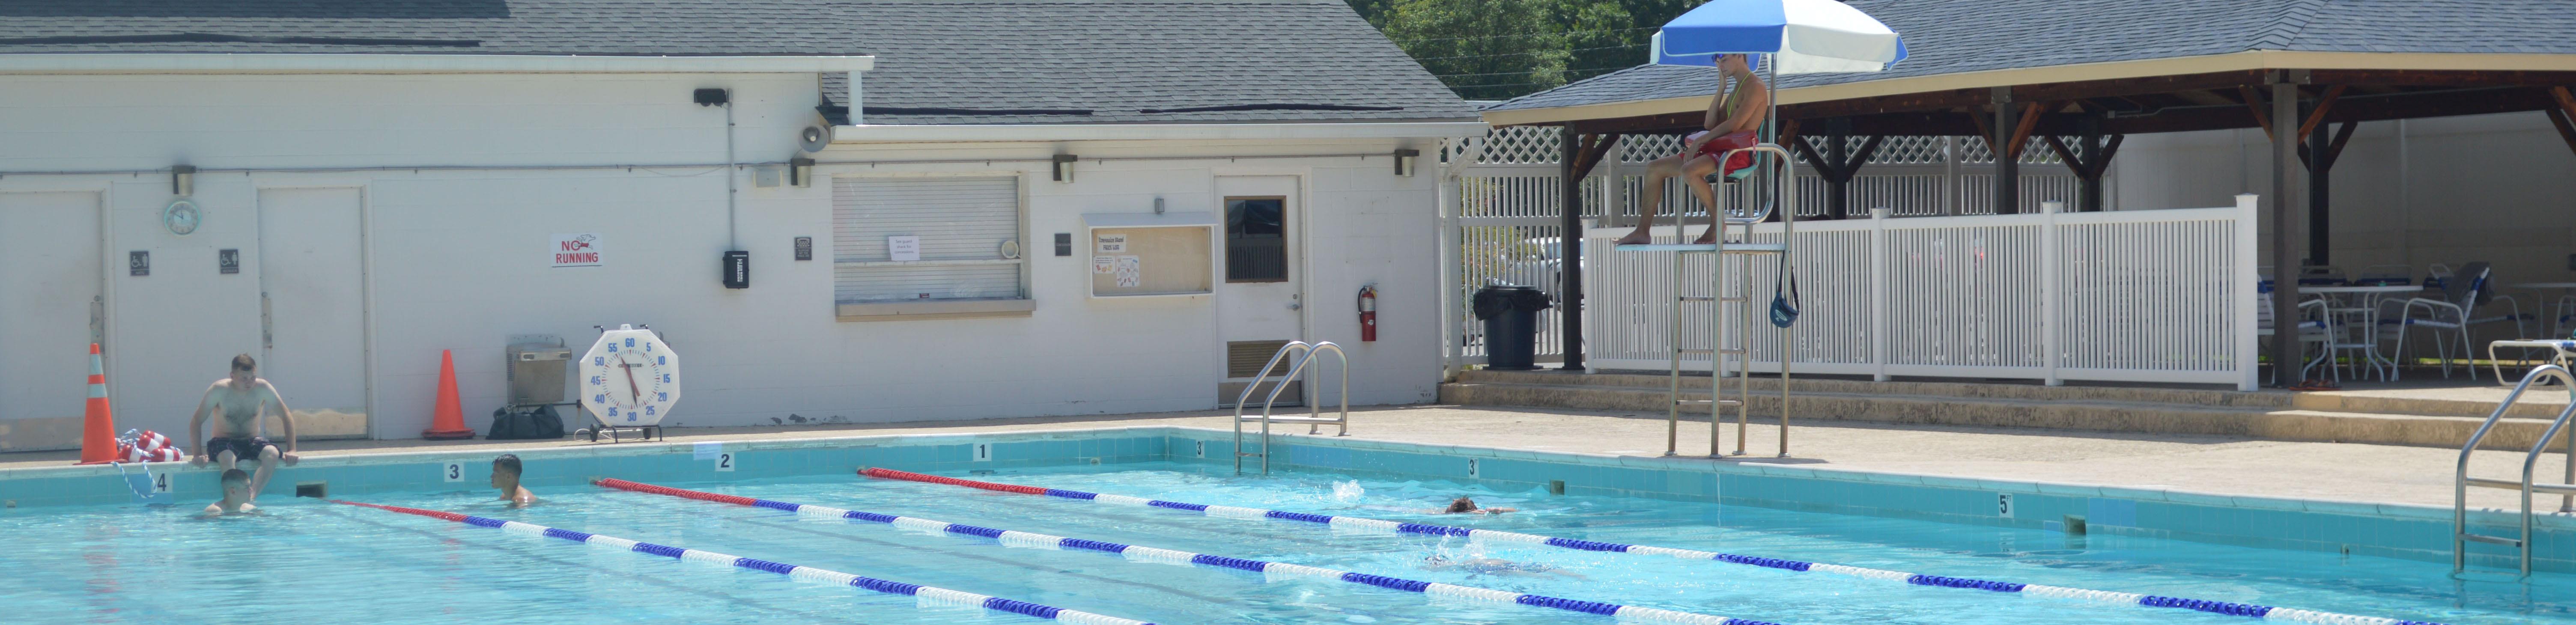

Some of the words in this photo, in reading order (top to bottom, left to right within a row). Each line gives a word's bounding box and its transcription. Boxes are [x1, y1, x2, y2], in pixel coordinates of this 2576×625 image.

[562, 240, 580, 251] NO
[556, 252, 598, 264] RUNNING
[608, 343, 617, 352] 55
[625, 338, 635, 347] 60
[647, 342, 651, 351] 5
[595, 357, 604, 366] 50
[658, 356, 665, 365] 10
[591, 376, 601, 385] 45
[663, 374, 670, 383] 15
[595, 394, 605, 404] 40
[658, 392, 667, 402] 20
[608, 407, 617, 417] 35
[646, 406, 655, 415] 25
[627, 412, 637, 421] 30
[980, 444, 985, 458] 1
[1197, 441, 1202, 455] 3
[721, 454, 730, 468] 2
[450, 464, 459, 479] 3
[1470, 459, 1474, 475] 3
[158, 473, 167, 491] 4
[2000, 495, 2007, 514] 5
